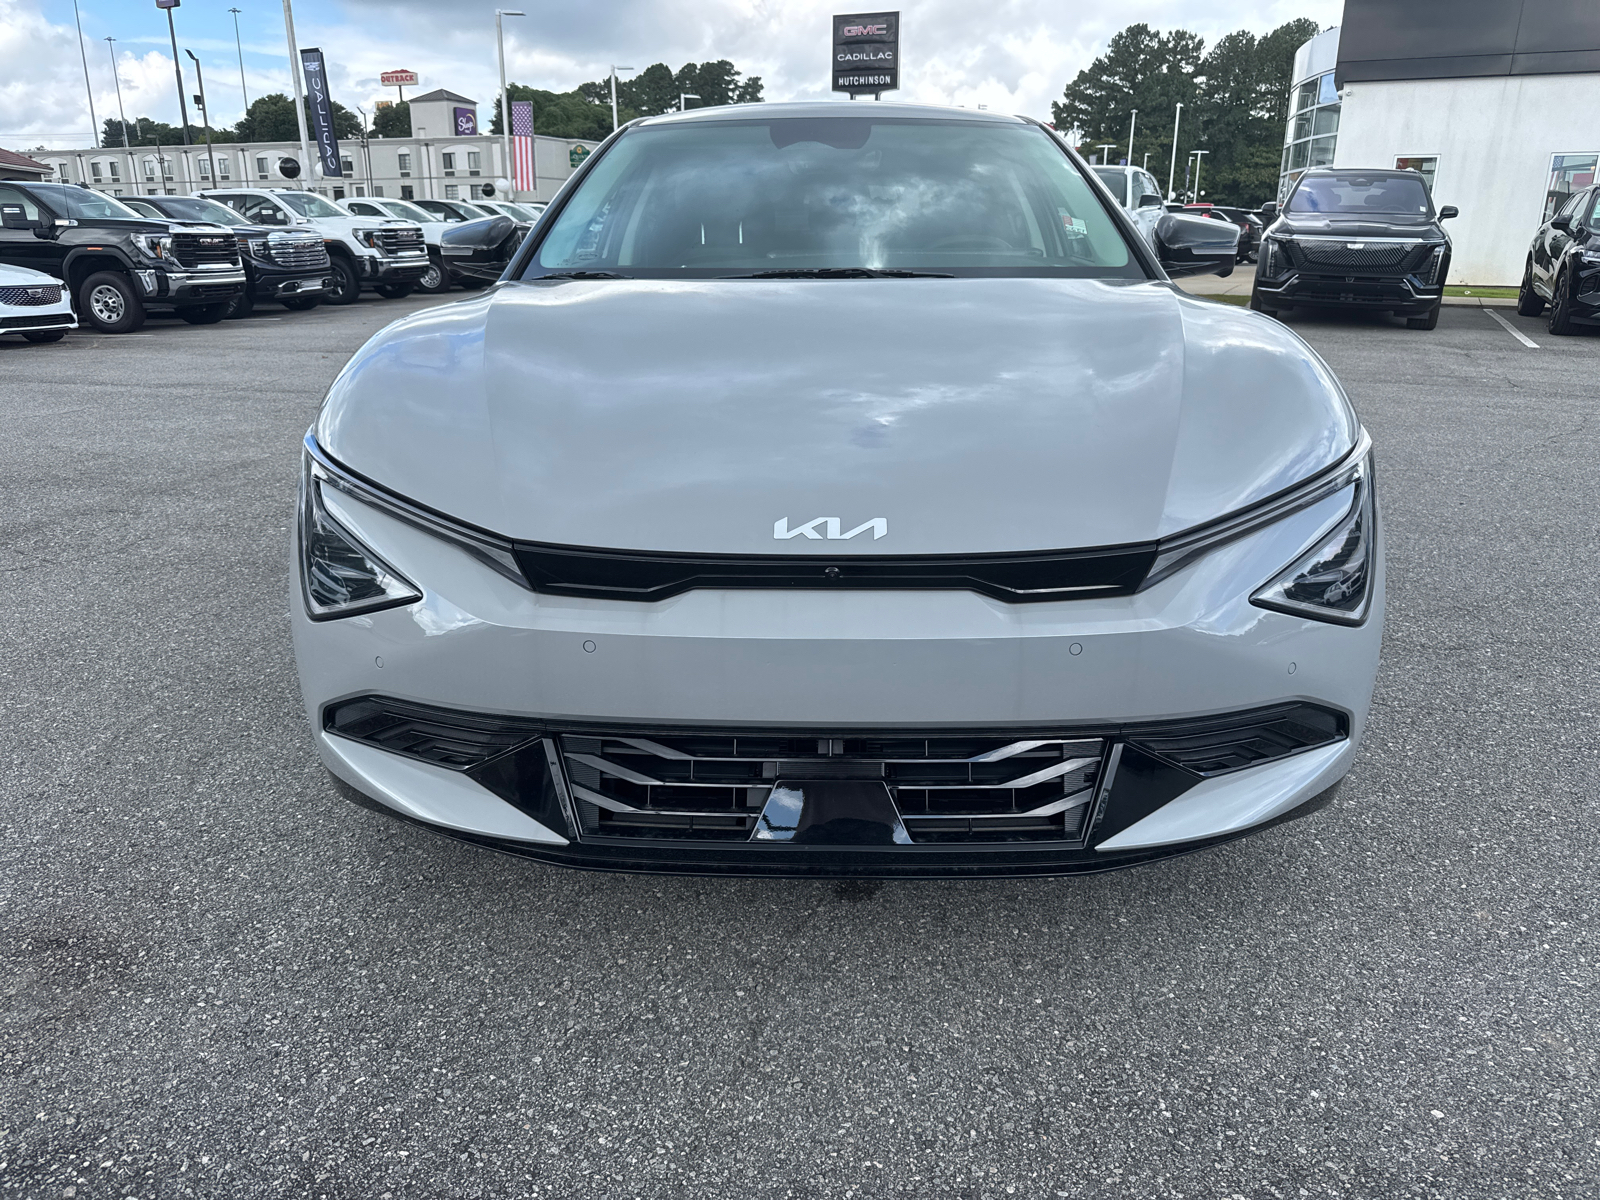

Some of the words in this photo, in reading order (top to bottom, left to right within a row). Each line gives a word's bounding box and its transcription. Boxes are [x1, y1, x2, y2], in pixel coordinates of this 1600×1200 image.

[844, 24, 887, 36] GMC
[837, 52, 893, 61] CADILLAC
[381, 74, 414, 83] OUTBACK
[838, 75, 891, 86] HUTCHINSON
[773, 516, 888, 541] KIA
